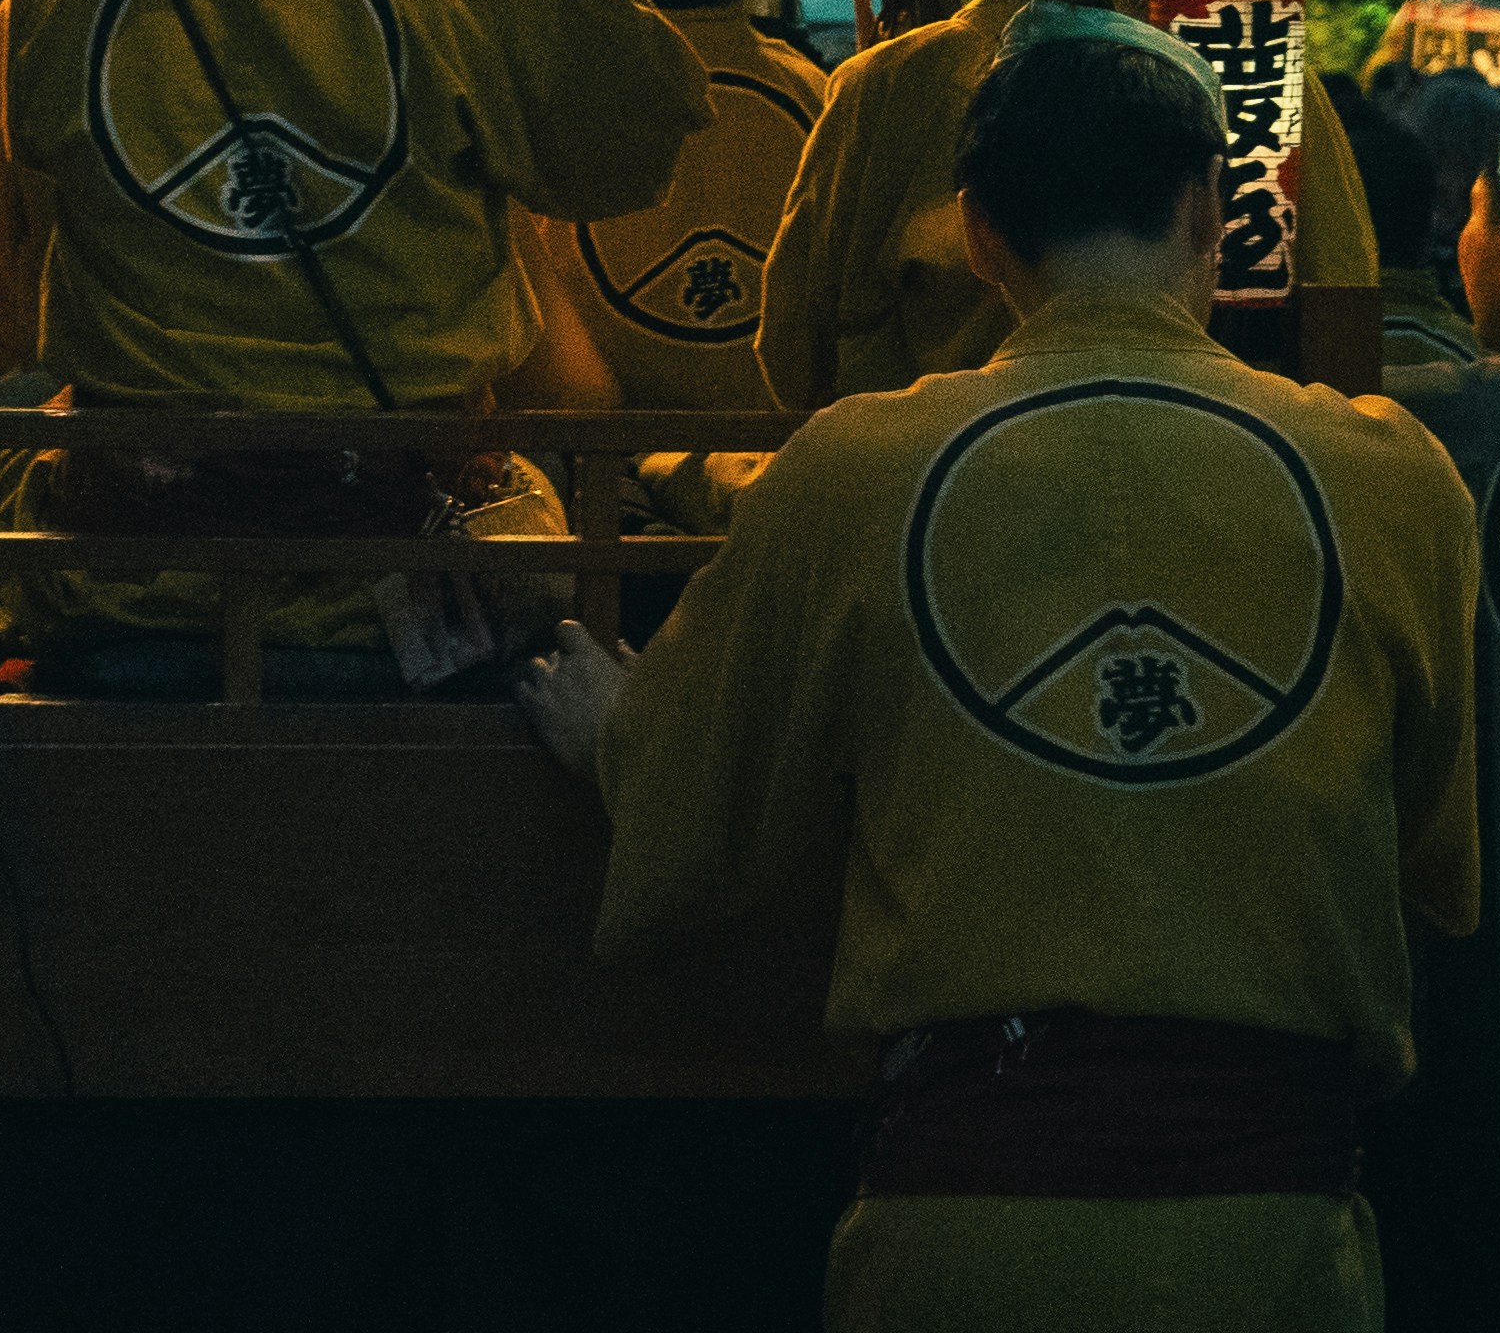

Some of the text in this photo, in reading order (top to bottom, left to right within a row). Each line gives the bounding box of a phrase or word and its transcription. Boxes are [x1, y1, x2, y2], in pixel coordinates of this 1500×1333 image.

[226, 148, 300, 226] 夢
[684, 259, 740, 319] 夢
[1100, 655, 1198, 751] 夢
